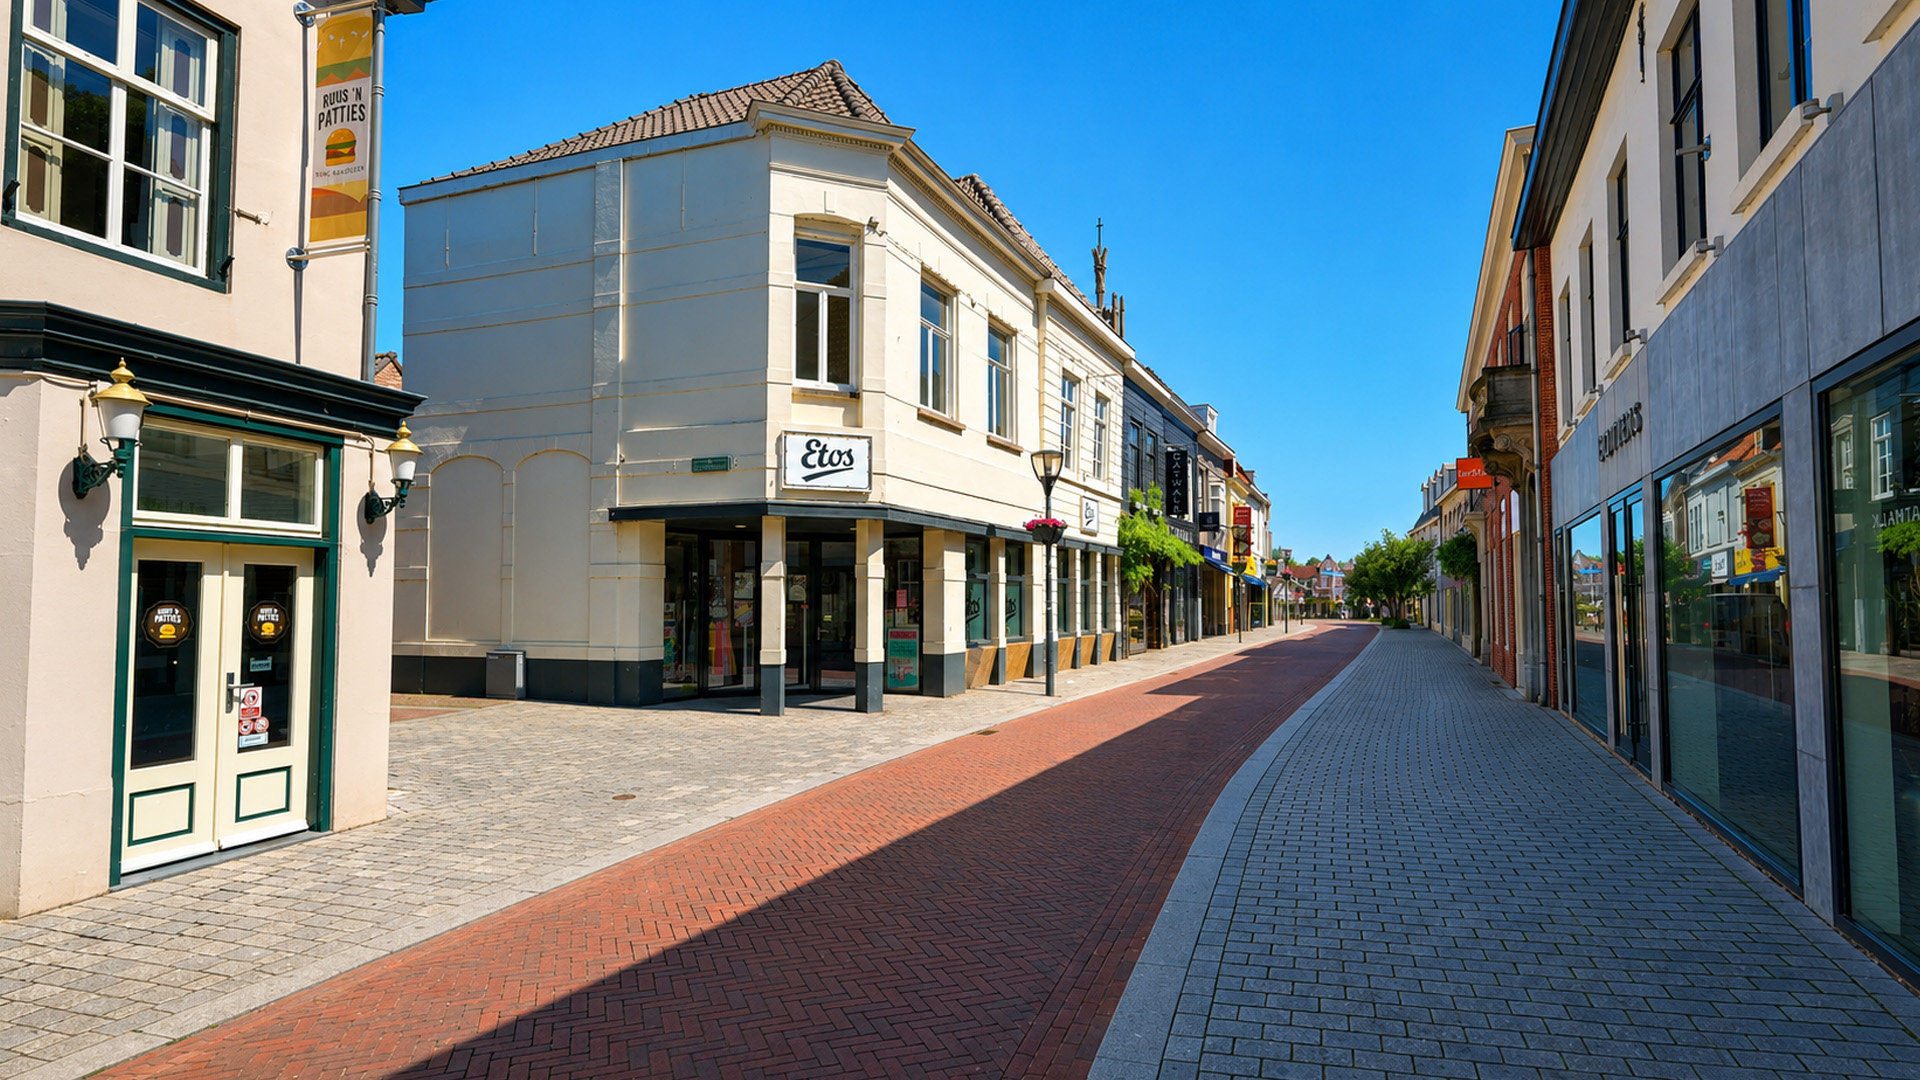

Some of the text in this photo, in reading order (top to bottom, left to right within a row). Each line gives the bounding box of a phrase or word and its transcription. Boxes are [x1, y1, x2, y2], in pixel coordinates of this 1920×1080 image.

[323, 87, 362, 108] RUUS 'N
[318, 104, 366, 130] PATTIES
[801, 438, 854, 469] Etos
